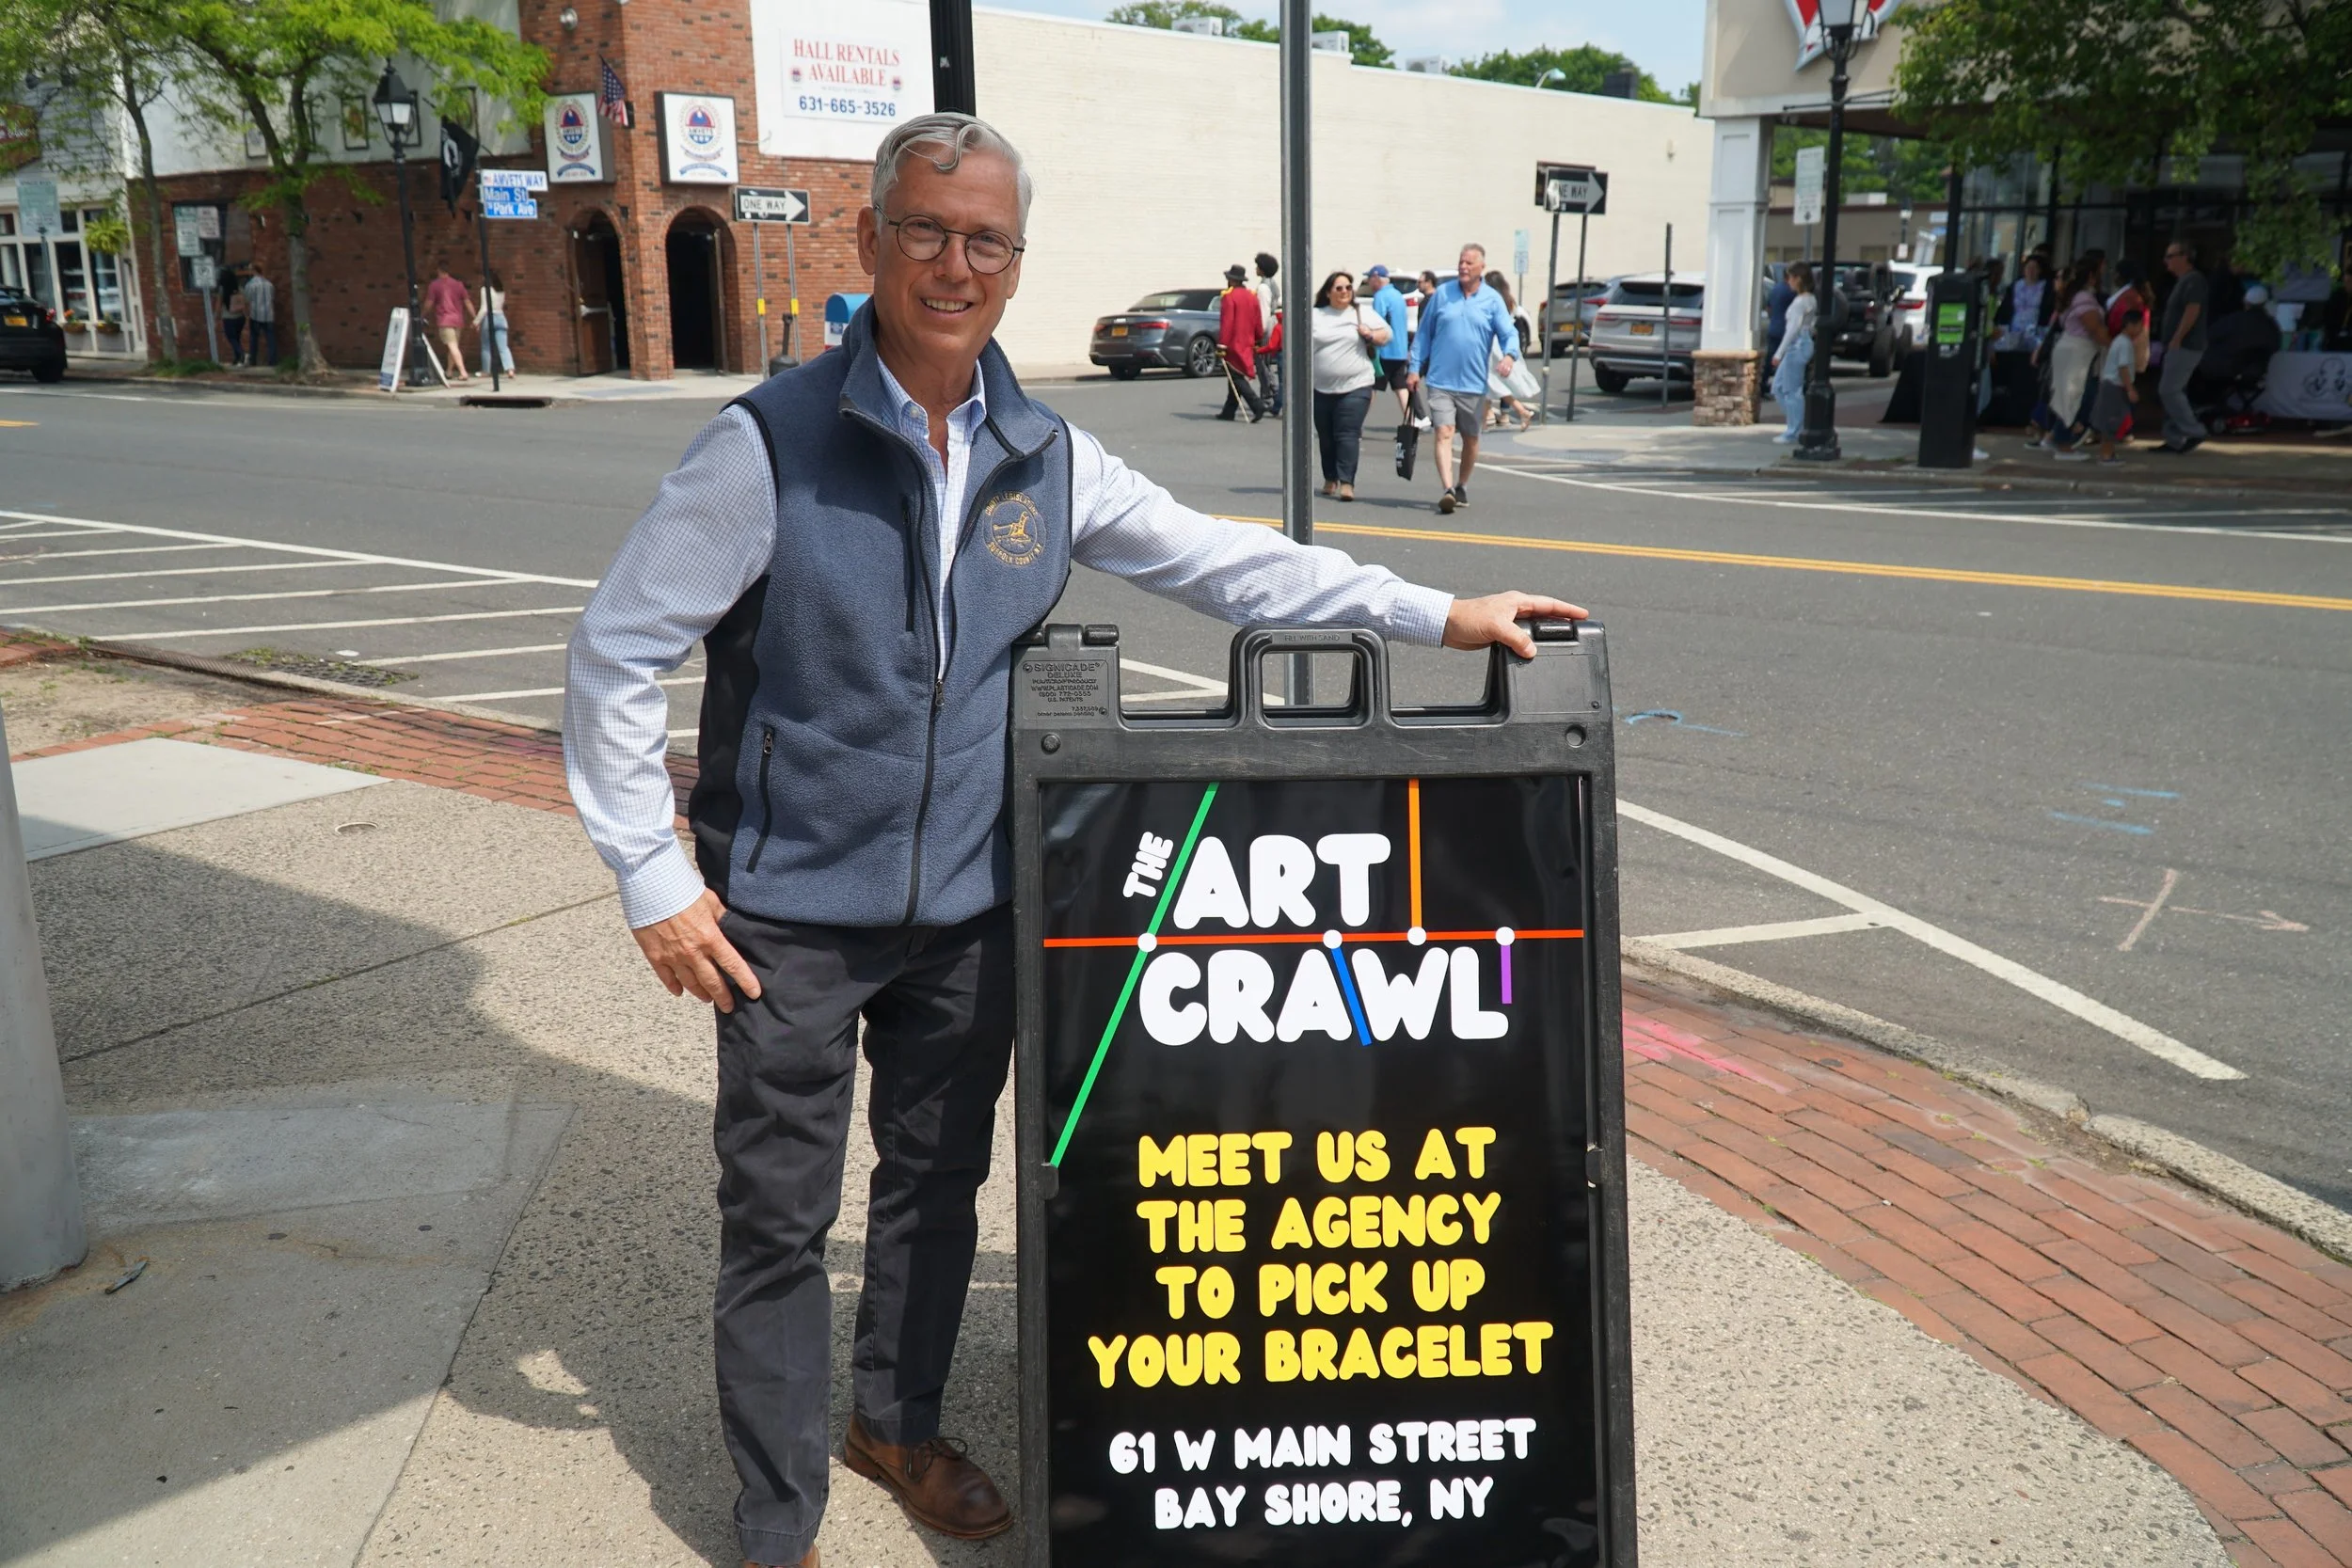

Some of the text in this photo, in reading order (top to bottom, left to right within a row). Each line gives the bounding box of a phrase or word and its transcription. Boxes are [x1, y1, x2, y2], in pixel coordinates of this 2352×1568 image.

[793, 39, 900, 66] HALL RENTALS
[810, 63, 886, 87] AVAILABLE
[799, 95, 897, 117] 631-665-3526
[493, 173, 544, 187] AMVETS WAY
[1571, 184, 1588, 199] WAY
[485, 187, 527, 201] Main St
[743, 198, 786, 211] ONE WAY
[493, 201, 515, 215] Park
[517, 202, 534, 215] Ave
[985, 495, 1001, 515] COUNTY
[988, 542, 1013, 563] SUFFOLK
[1015, 552, 1035, 565] COUNTY
[1122, 832, 1391, 929] THE ART
[1139, 946, 1509, 1045] CRAWL
[1138, 1127, 1496, 1187] MEET US AT
[1136, 1192, 1502, 1253] THE AGENCY
[1155, 1259, 1486, 1319] TO PICK UP
[1088, 1322, 1553, 1387] YOUR BRACELET
[1108, 1418, 1536, 1474] 61 W MAIN STREET
[1155, 1477, 1494, 1529] BAY SHORE, NY
